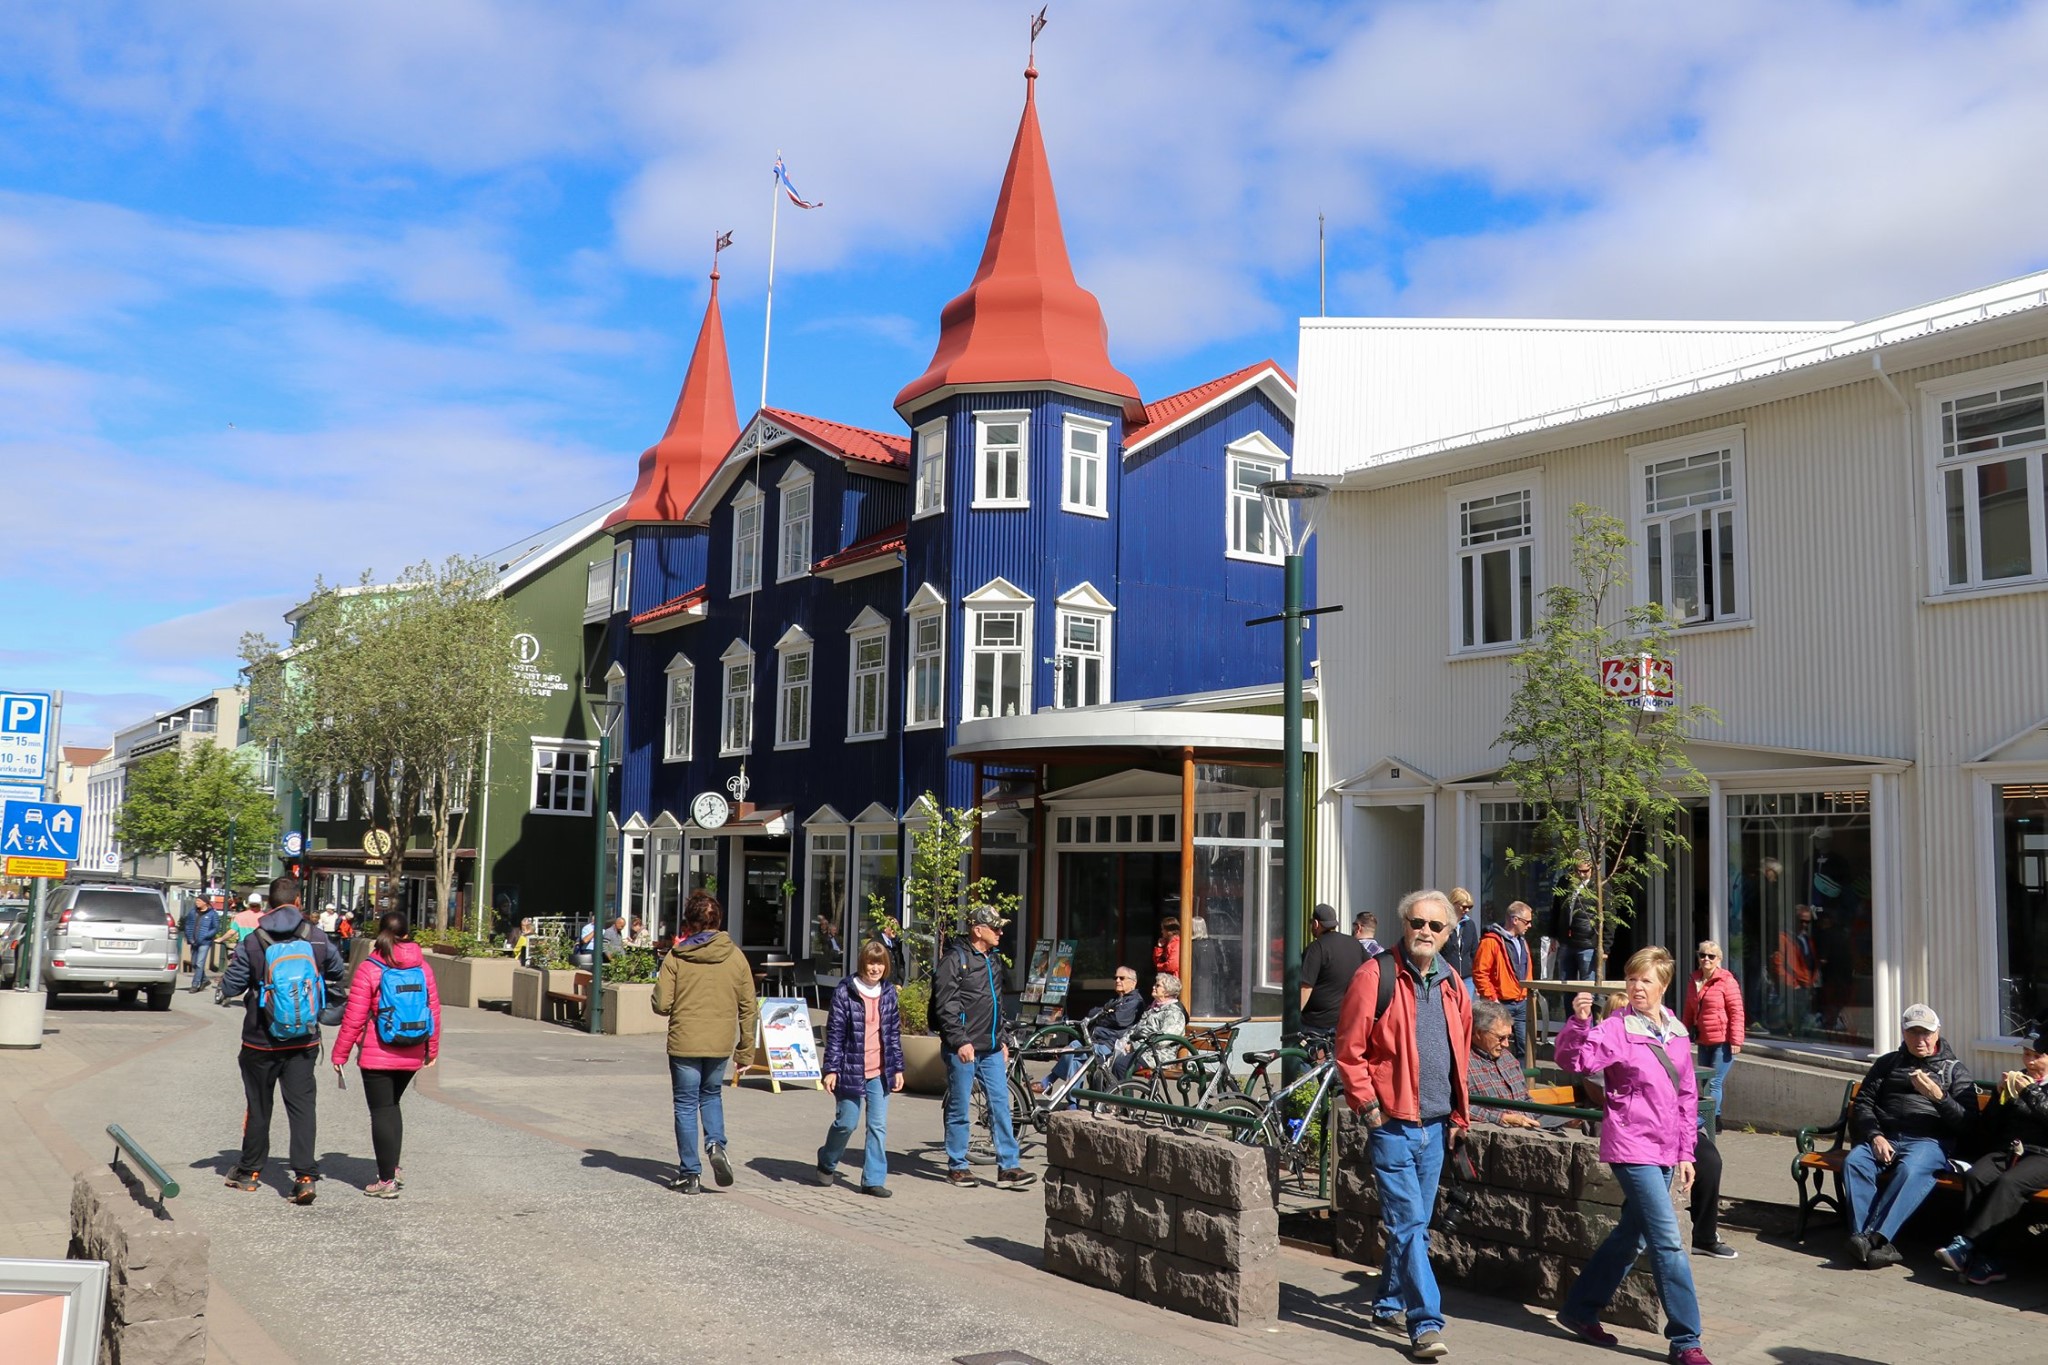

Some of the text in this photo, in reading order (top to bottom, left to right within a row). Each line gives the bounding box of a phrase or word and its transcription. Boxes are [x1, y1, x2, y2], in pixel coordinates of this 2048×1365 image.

[8, 700, 36, 732] P
[16, 736, 28, 747] 15
[1, 753, 13, 763] 10
[25, 754, 37, 764] 16
